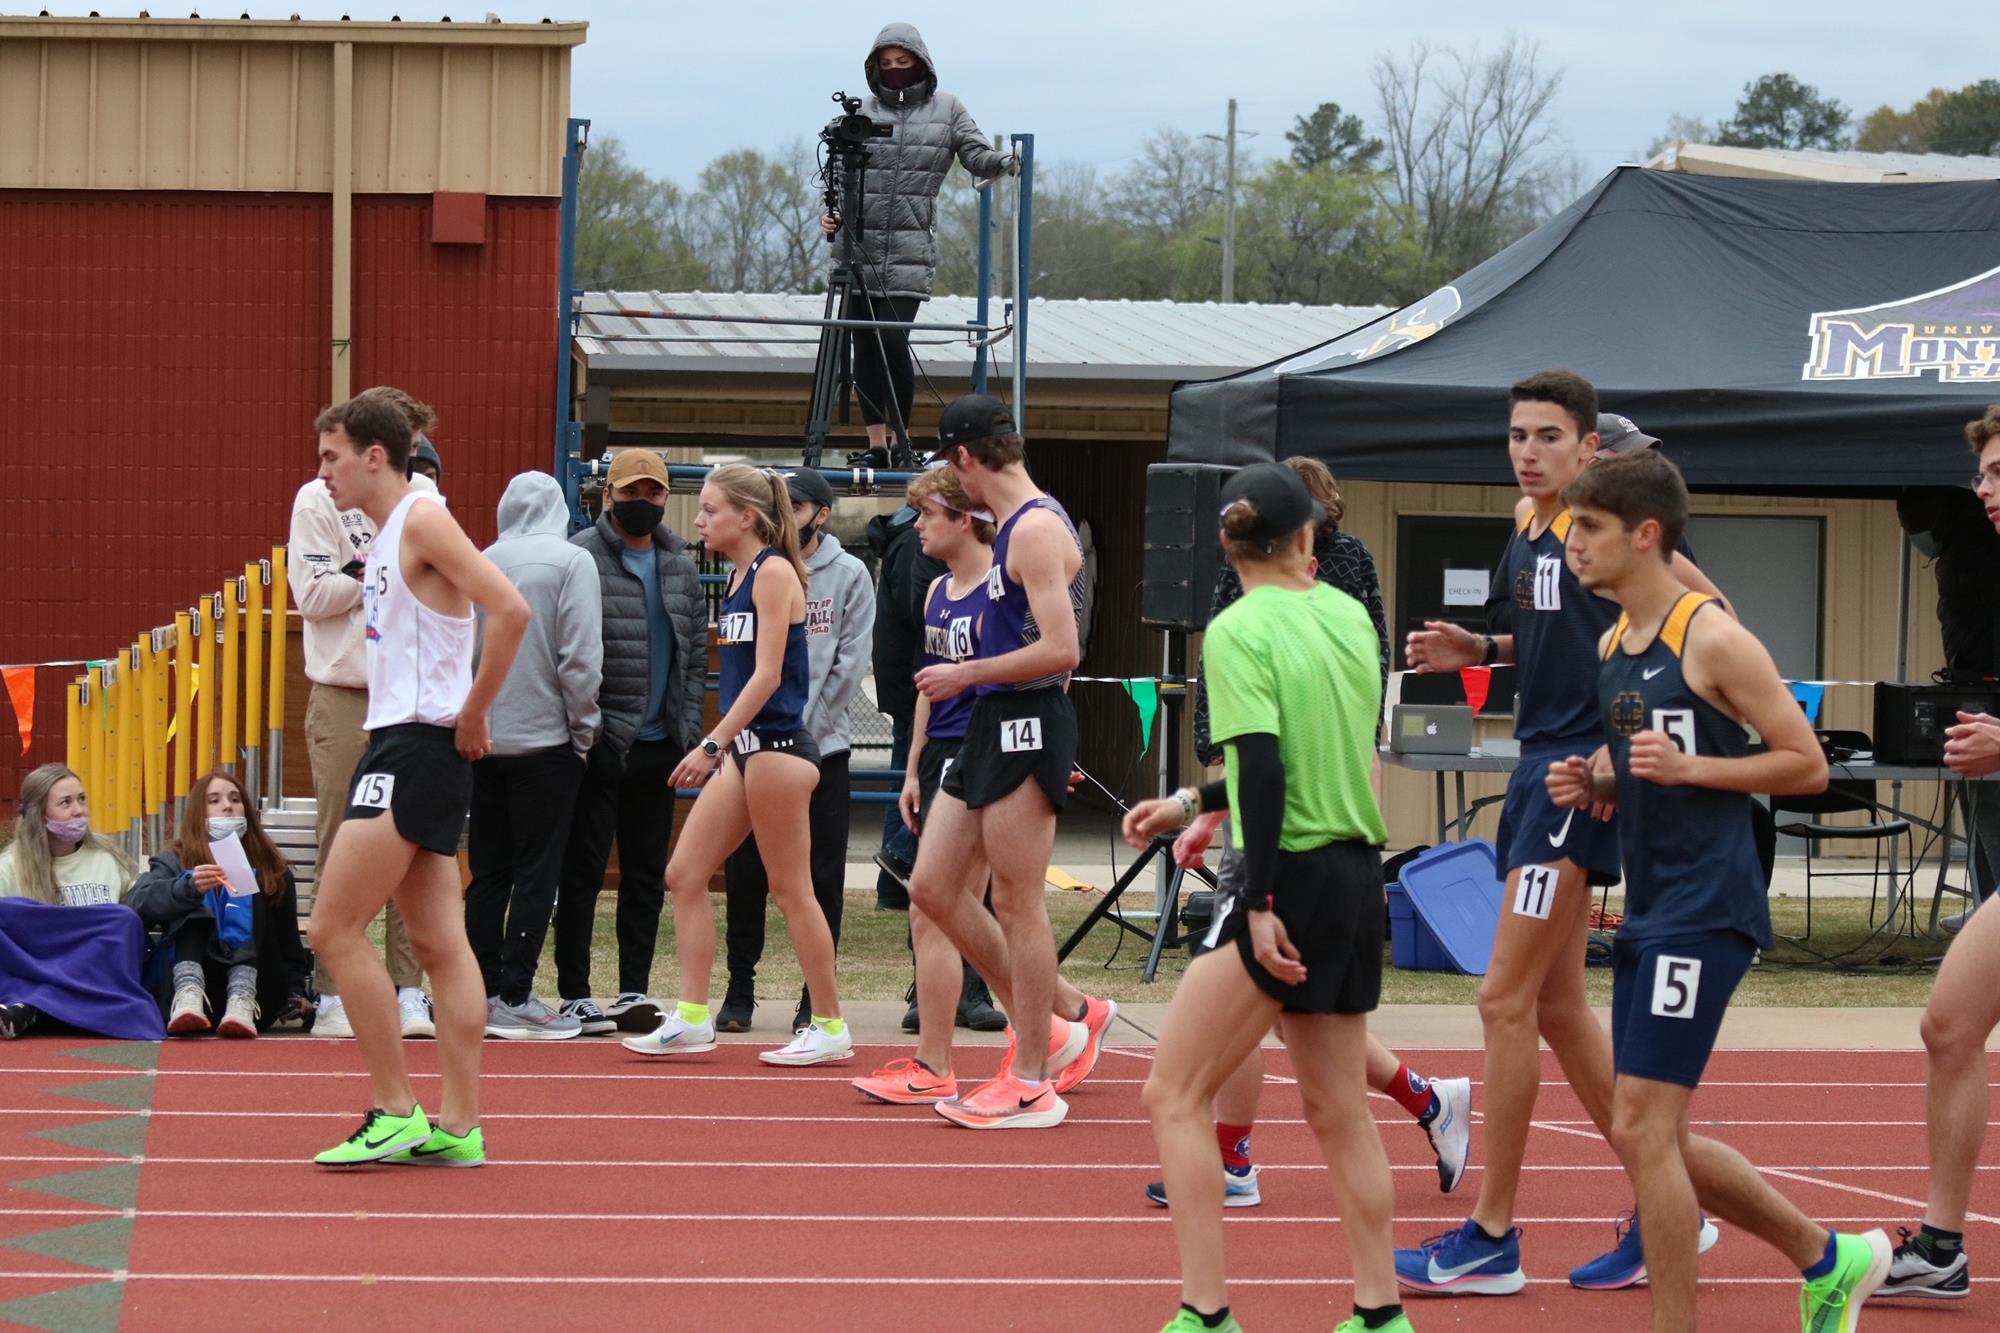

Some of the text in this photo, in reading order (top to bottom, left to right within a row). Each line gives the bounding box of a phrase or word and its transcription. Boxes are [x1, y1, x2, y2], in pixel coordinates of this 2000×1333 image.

[1448, 586, 1482, 596] CHECK-IN
[1538, 561, 1555, 608] 11
[729, 614, 747, 640] 17
[952, 619, 969, 656] 16
[1008, 720, 1036, 750] 14
[1662, 714, 1687, 757] 5
[361, 775, 387, 805] 15
[1522, 867, 1550, 915] 11
[1662, 961, 1692, 1014] 5
